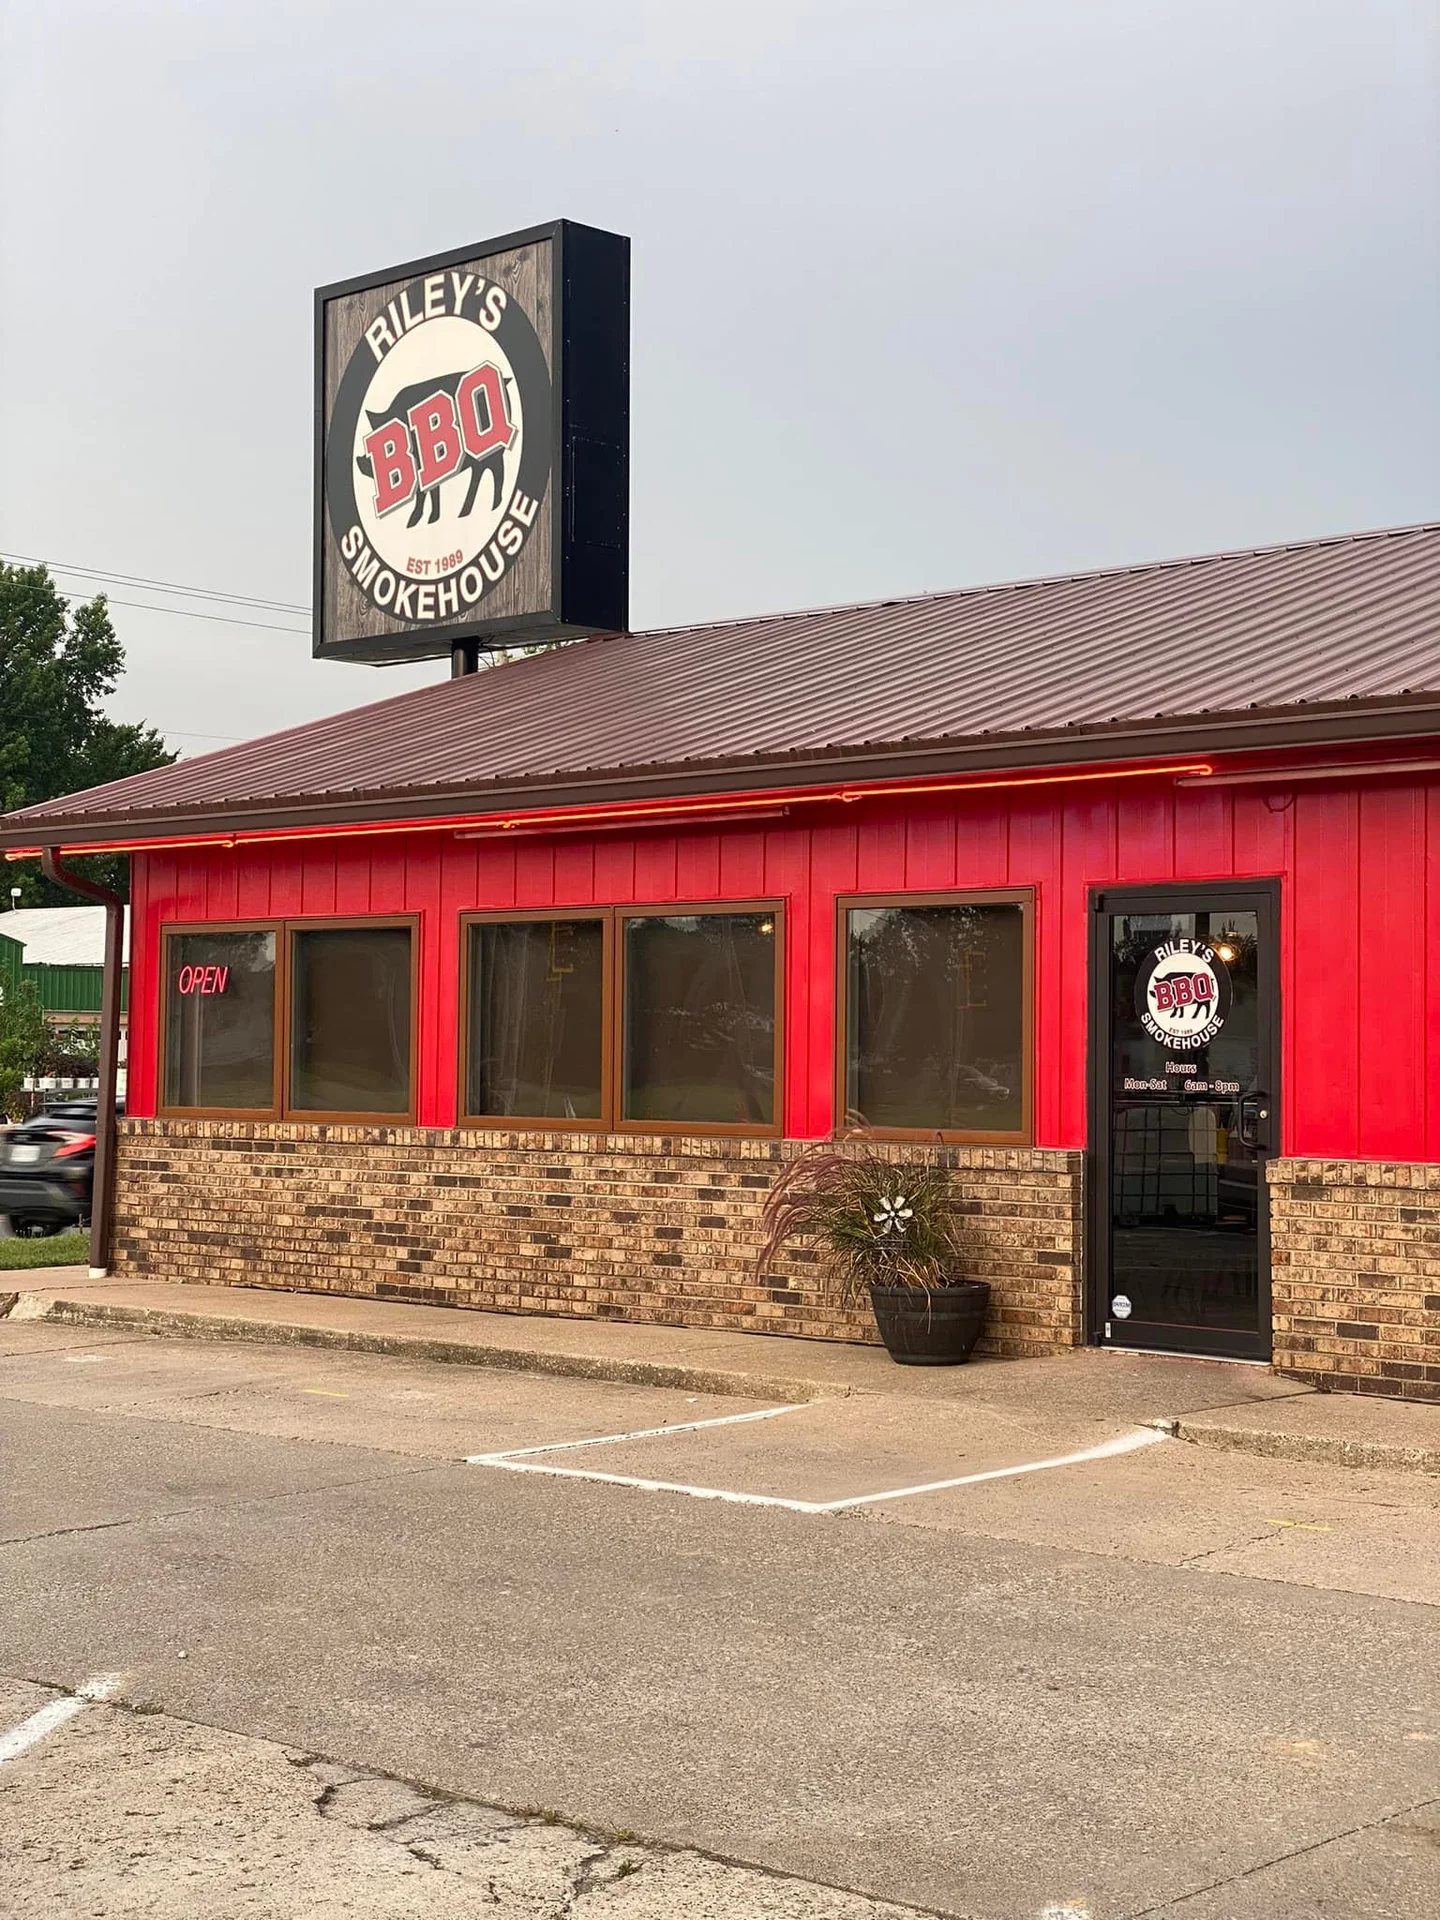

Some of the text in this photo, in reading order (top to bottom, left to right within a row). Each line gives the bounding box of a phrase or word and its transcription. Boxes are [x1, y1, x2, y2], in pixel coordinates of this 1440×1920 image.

[365, 272, 508, 363] RILEY'S
[364, 359, 518, 519] BBQ
[341, 489, 539, 620] SMOKEHOUSE
[406, 549, 463, 575] EST 1989
[1154, 938, 1214, 963] RILEY'S
[179, 965, 228, 994] OPEN
[1153, 972, 1216, 1012] BBQ
[1141, 1012, 1224, 1049] SMOKEHOUSE
[1124, 1077, 1168, 1091] Mon-Sat
[1165, 1061, 1198, 1075] Hours
